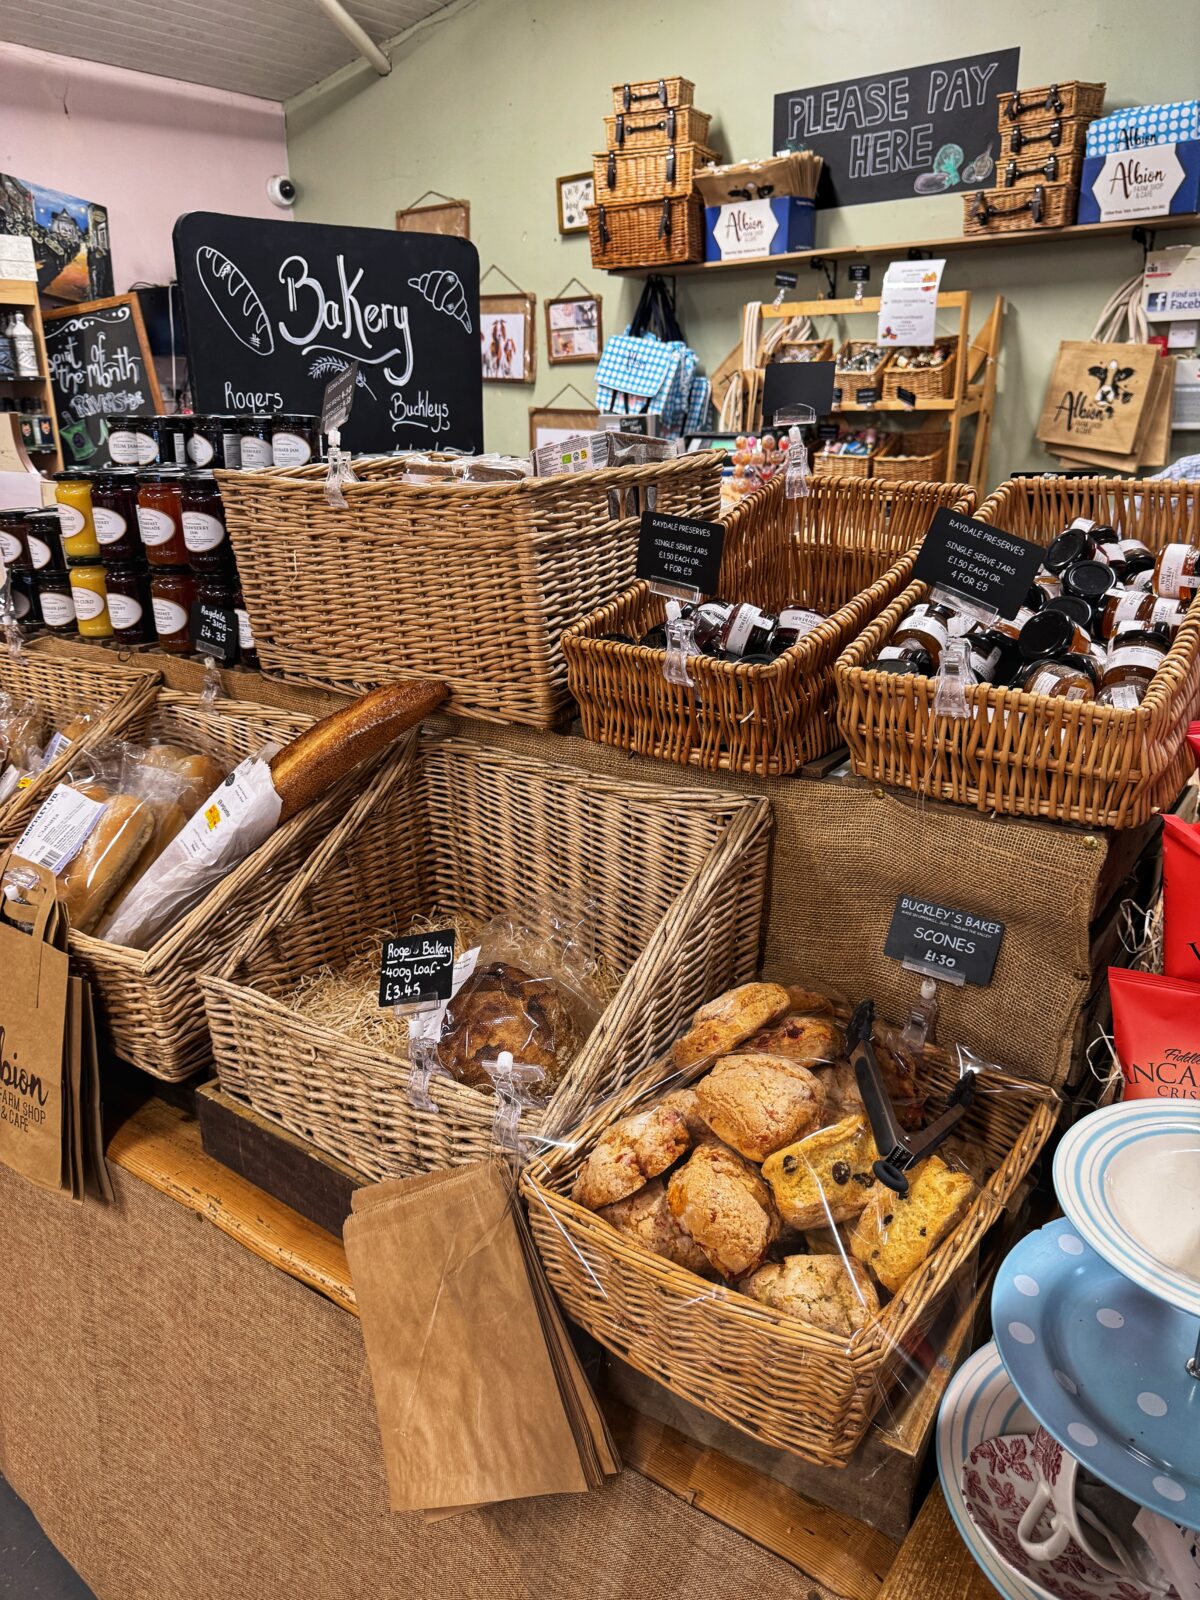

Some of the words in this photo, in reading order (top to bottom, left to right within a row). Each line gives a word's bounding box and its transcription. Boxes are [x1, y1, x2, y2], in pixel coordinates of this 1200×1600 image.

[787, 77, 910, 141] PLEASE
[927, 63, 999, 114] PAY
[849, 123, 934, 179] HERE
[1110, 159, 1166, 199] Albion
[278, 254, 414, 387] Bakery
[224, 381, 284, 414] Rogers
[389, 390, 450, 432] Buckleys
[1053, 390, 1104, 432] Albion
[652, 519, 679, 531] RAYDALE
[679, 524, 711, 537] PRESERVES
[948, 518, 983, 539] RAYDALE
[983, 532, 1026, 556] PRESERVES
[654, 538, 675, 549] SINGLE
[675, 542, 693, 553] SERVE
[693, 546, 708, 556] JARS
[674, 553, 690, 564] EACH
[945, 540, 973, 557] SINGLE
[972, 552, 997, 567] SERVE
[996, 561, 1017, 576] JARS
[669, 564, 682, 573] FOR
[683, 567, 693, 576] £5
[947, 555, 968, 569] £1.50
[967, 563, 989, 578] EACH
[951, 570, 957, 578] 4
[957, 572, 975, 587] FOR
[976, 580, 989, 592] £5
[900, 898, 963, 924] BUCKLEY'S
[422, 940, 453, 967] Bakery
[913, 927, 976, 954] SCONES
[385, 981, 421, 1001] £3.45
[0, 1105, 8, 1121] &
[9, 1109, 29, 1133] CAFE
[22, 1101, 46, 1125] SHOP
